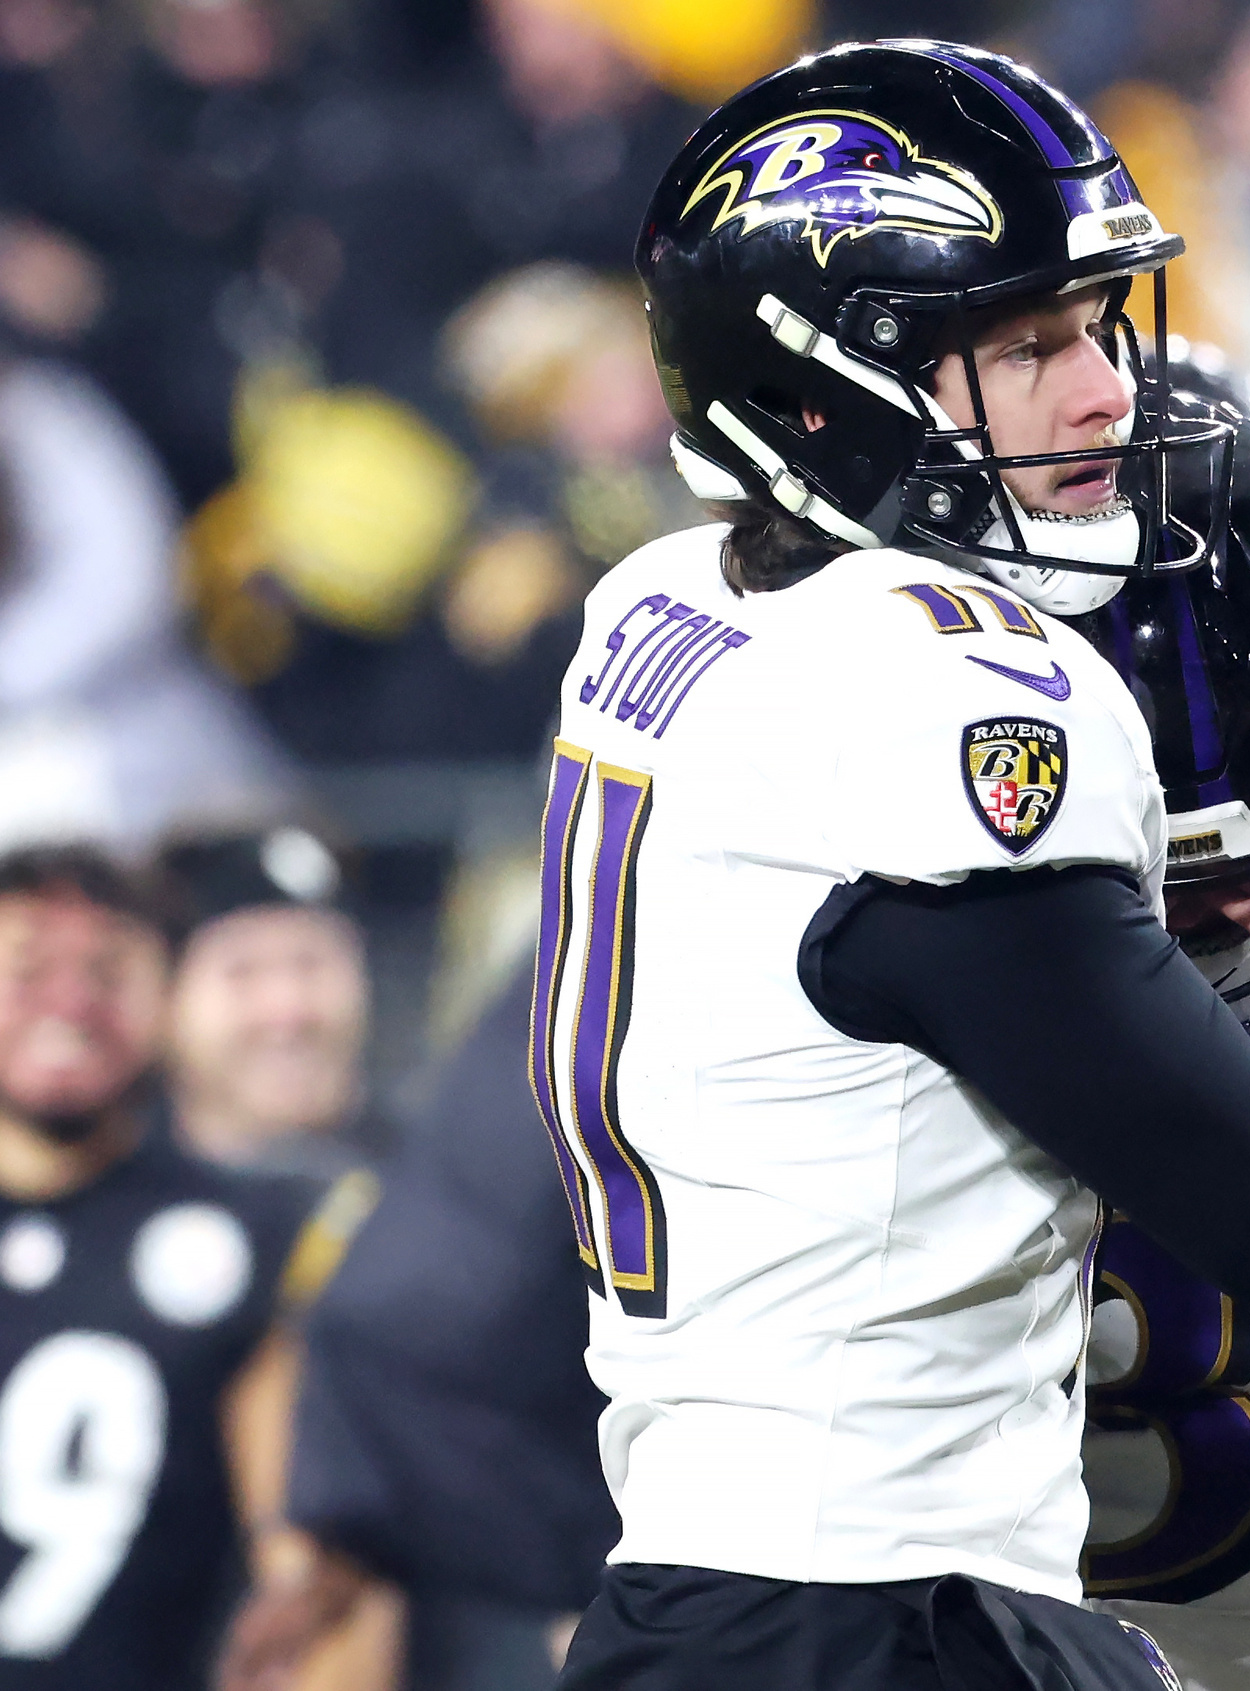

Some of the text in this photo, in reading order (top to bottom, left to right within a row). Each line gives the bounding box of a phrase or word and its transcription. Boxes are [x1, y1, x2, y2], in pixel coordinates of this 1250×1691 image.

[738, 122, 843, 199] B
[1101, 214, 1153, 240] RAVENS
[887, 583, 1049, 645] 11
[579, 592, 753, 740] STOUT
[970, 723, 1058, 743] RAVENS
[972, 741, 1021, 781] B
[1167, 829, 1222, 859] VENS
[527, 735, 668, 1320] 11
